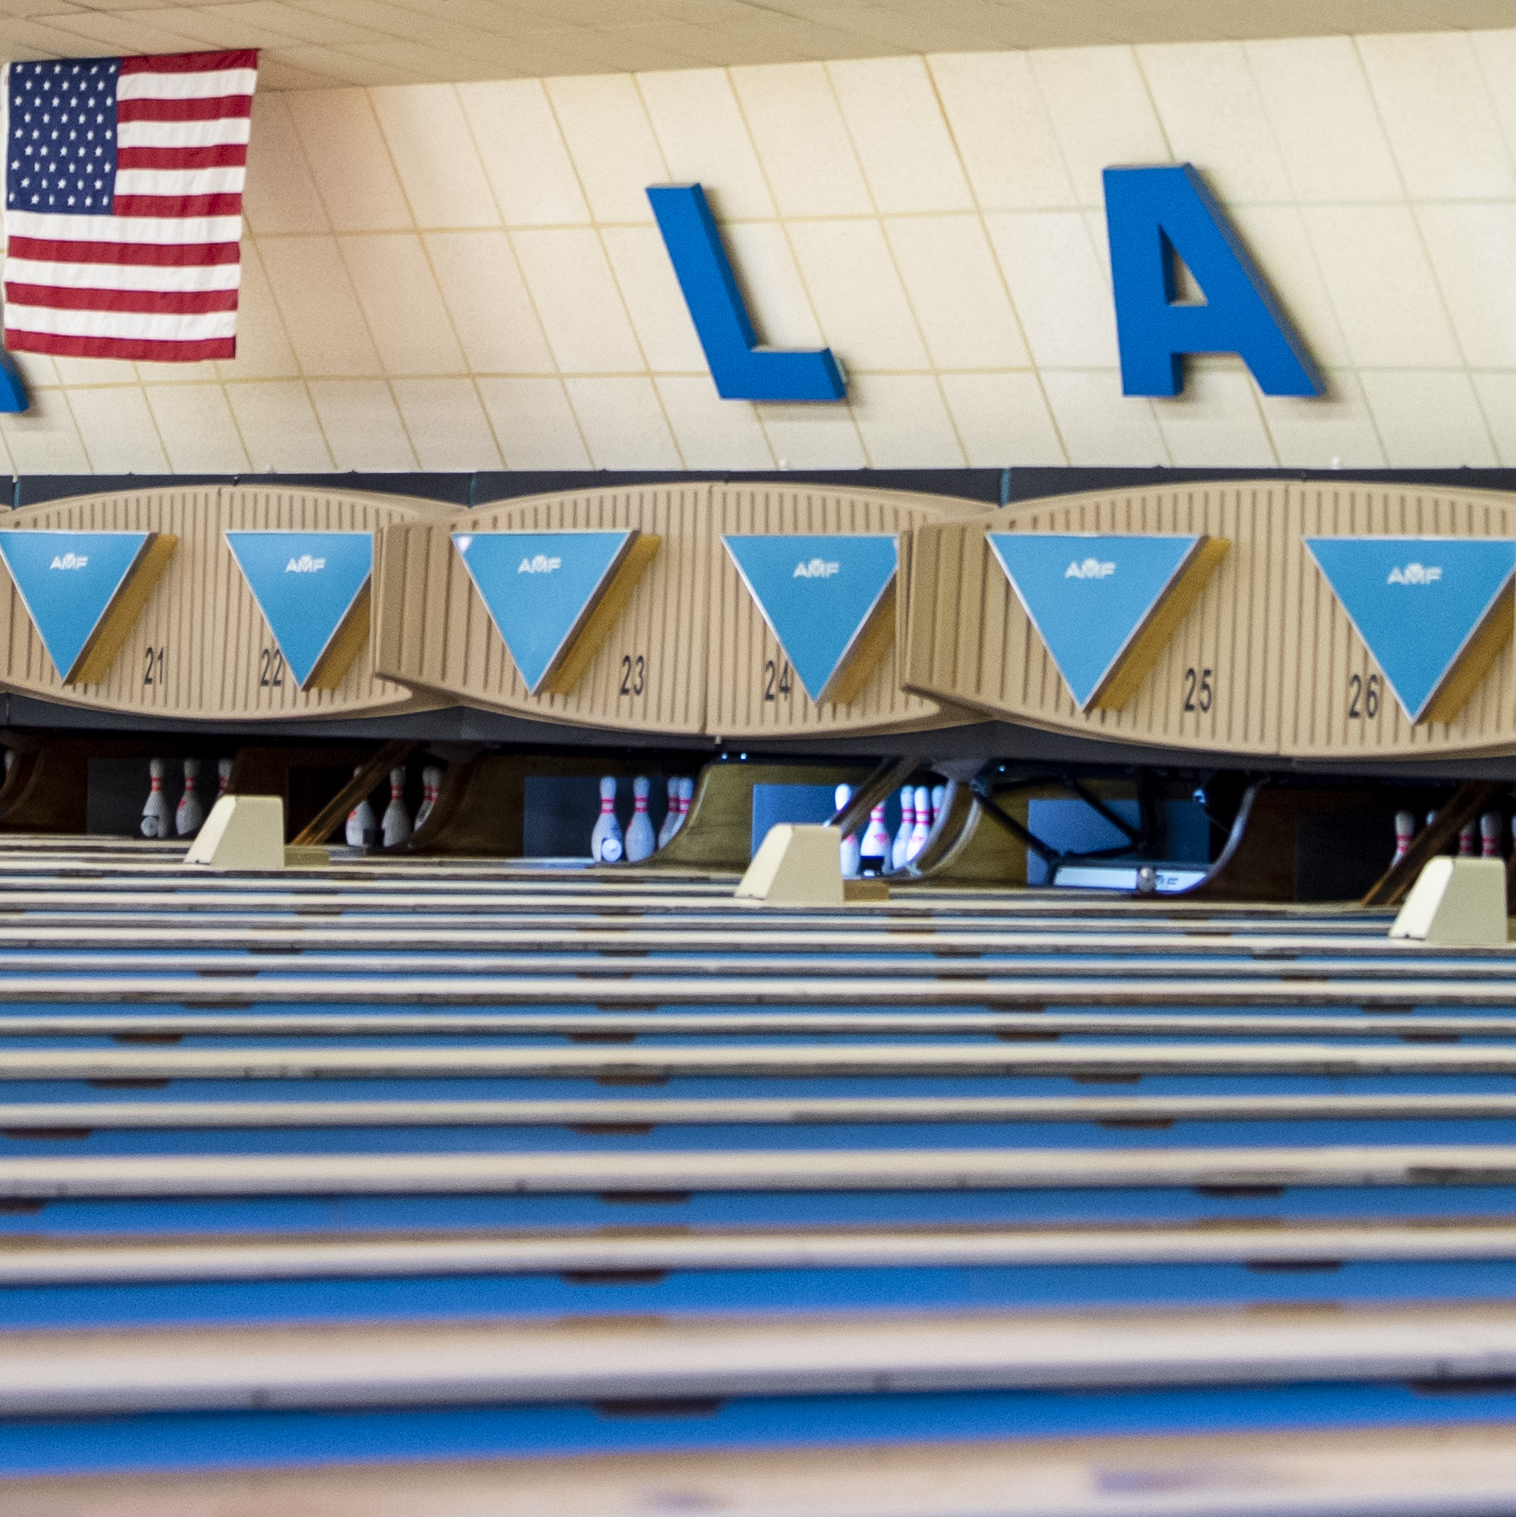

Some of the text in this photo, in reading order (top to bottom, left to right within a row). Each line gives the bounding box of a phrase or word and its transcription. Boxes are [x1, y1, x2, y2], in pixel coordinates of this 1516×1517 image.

[49, 551, 89, 570] AMF
[285, 553, 326, 573] AMF
[517, 554, 562, 574] AMF
[793, 557, 840, 579] AMF
[1064, 557, 1116, 579] AMF
[1387, 562, 1443, 585] AMF
[144, 647, 164, 684] 21
[261, 648, 282, 685] 22
[620, 655, 644, 695] 23
[764, 660, 790, 701] 24
[1184, 668, 1213, 712] 25
[1348, 674, 1379, 719] 26
